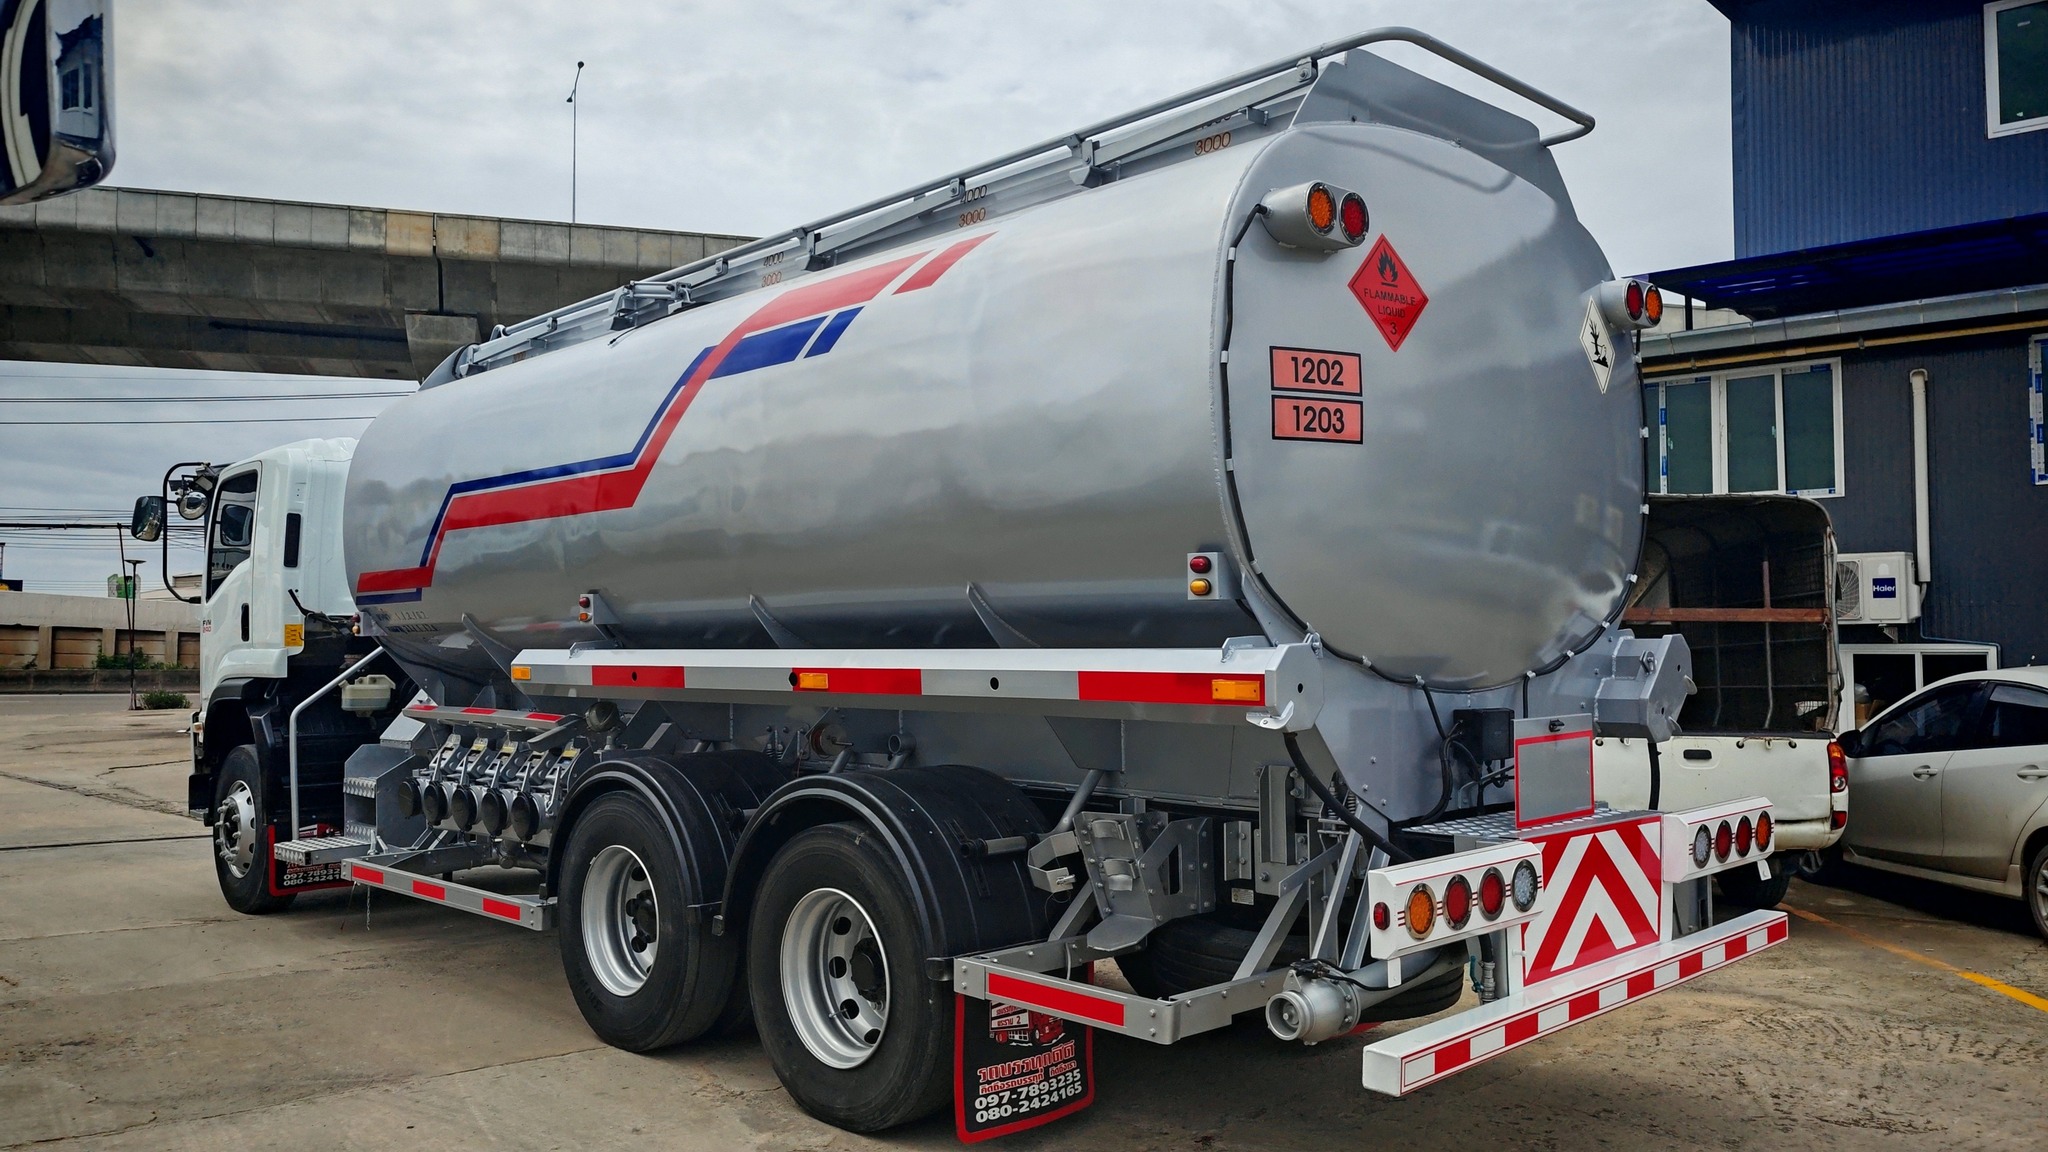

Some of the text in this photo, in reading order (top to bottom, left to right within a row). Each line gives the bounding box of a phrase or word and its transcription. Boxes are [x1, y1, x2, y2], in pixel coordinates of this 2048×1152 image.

[1195, 131, 1231, 156] 3000
[959, 207, 986, 228] 3000
[761, 271, 782, 288] 3000
[1363, 287, 1416, 306] FLAMMABLE
[1378, 304, 1405, 319] LIQUID
[1390, 321, 1397, 335] 3
[1291, 356, 1344, 386] 1202
[1293, 405, 1345, 434] 1203
[1873, 584, 1895, 592] Haier
[283, 869, 340, 880] 097-78932
[283, 875, 340, 886] 080-24241
[1016, 1015, 1022, 1025] 2
[974, 1068, 1081, 1109] 097-7893235
[975, 1081, 1083, 1123] 080-2424165
